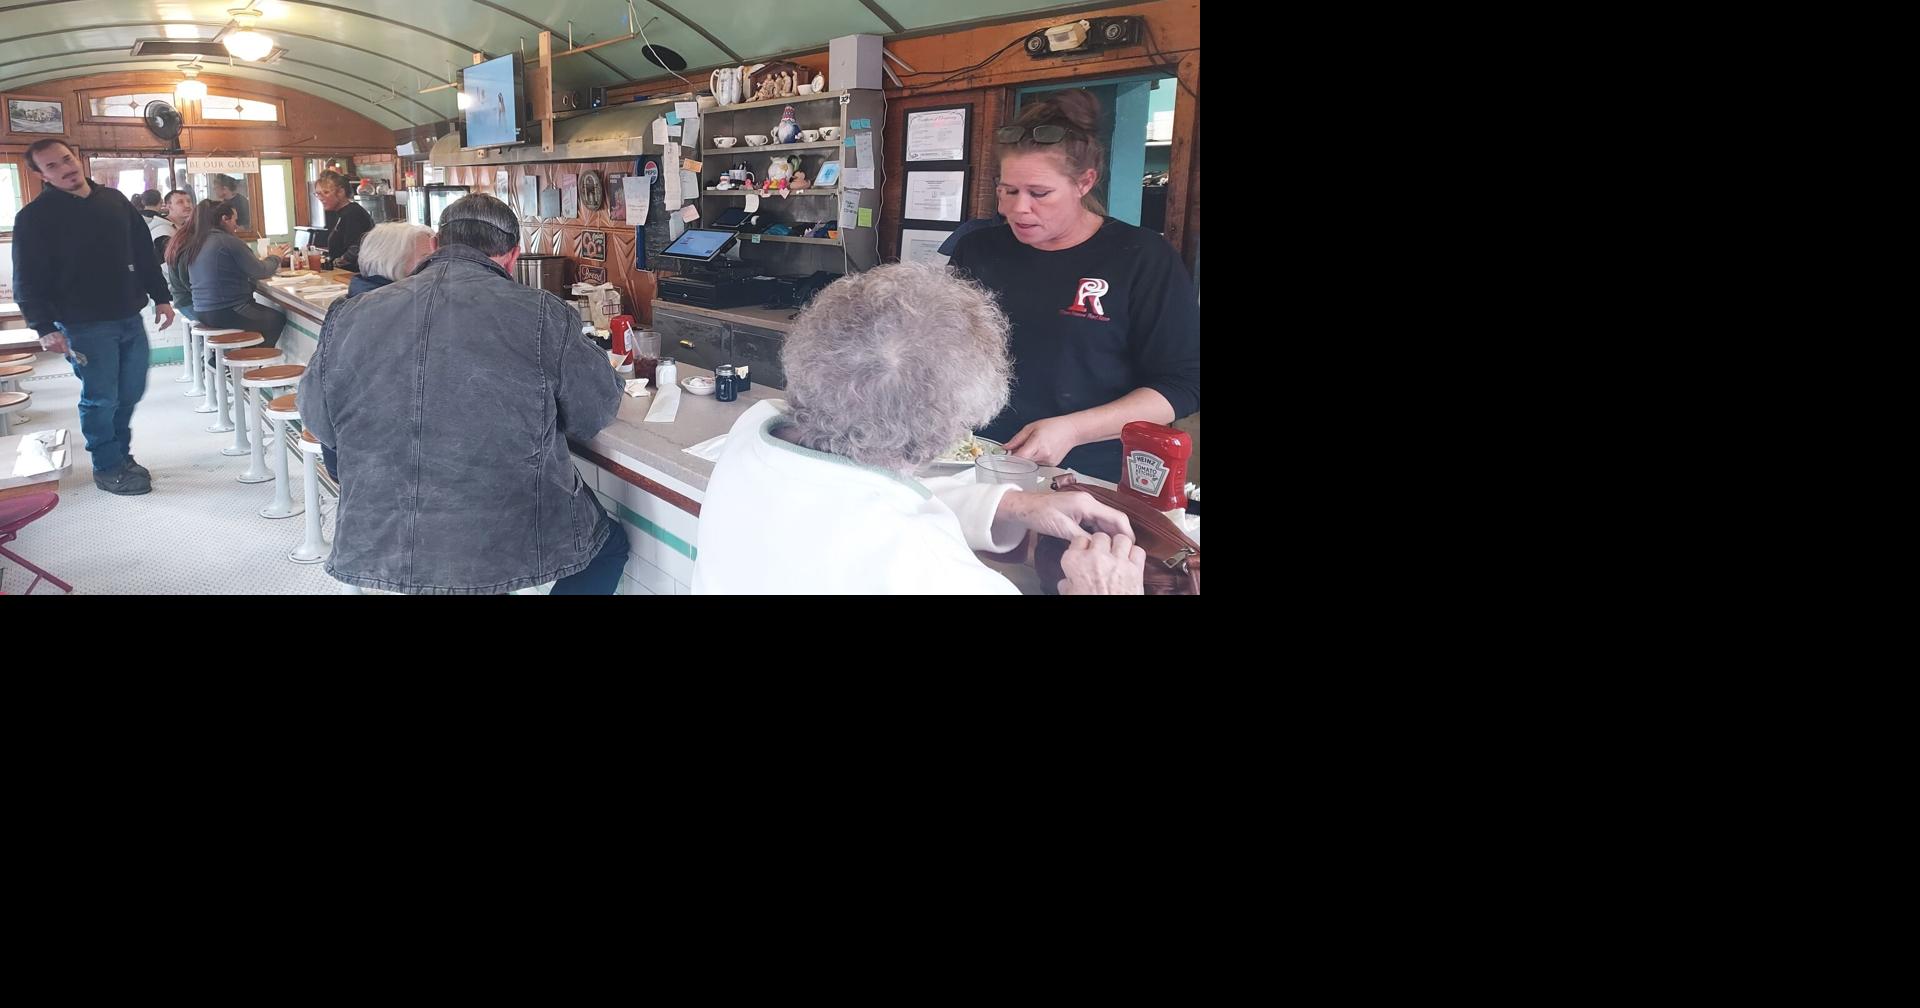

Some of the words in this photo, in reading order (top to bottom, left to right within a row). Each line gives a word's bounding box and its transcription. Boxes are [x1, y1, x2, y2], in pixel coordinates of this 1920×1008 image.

[203, 160, 223, 168] OUR
[227, 160, 256, 168] GUEST
[1136, 456, 1156, 466] HEINZ
[1135, 464, 1157, 475] TOMATO
